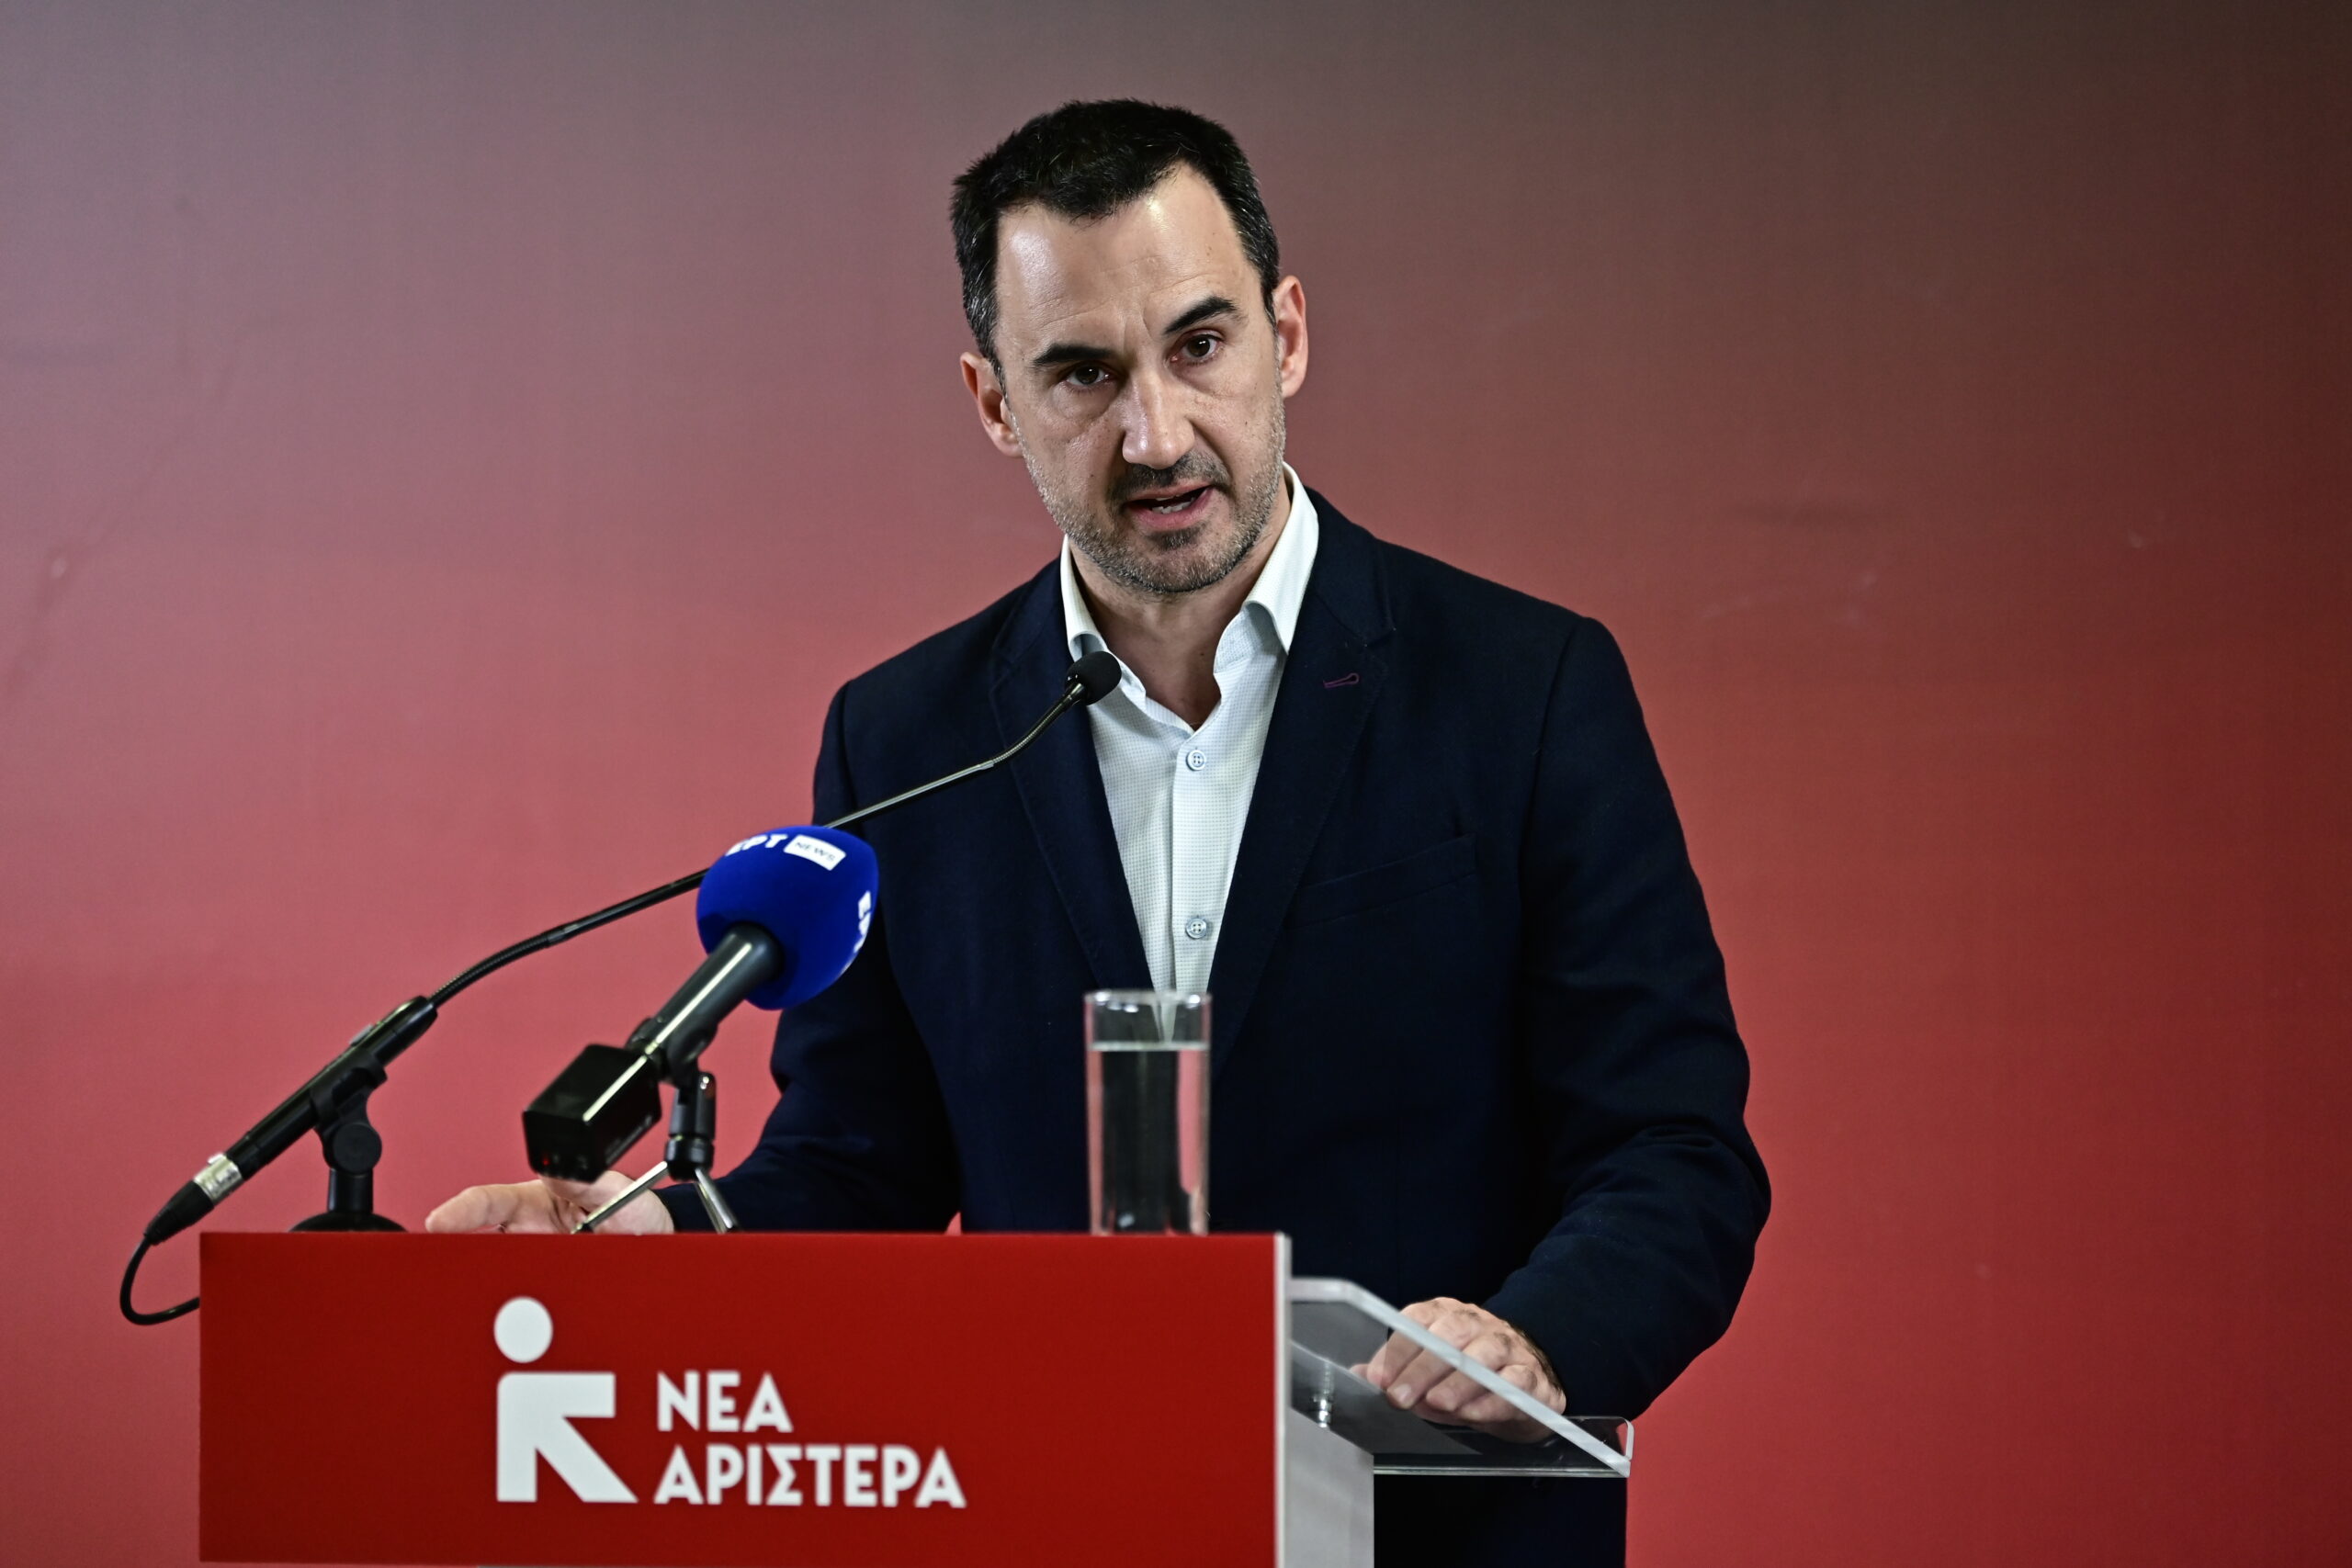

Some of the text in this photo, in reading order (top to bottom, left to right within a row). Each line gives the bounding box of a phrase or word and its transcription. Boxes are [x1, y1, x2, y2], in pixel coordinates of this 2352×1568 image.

[795, 840, 837, 863] NEWS
[657, 1371, 794, 1433] ΝΕΑ
[653, 1443, 967, 1508] ΑΡΙΣΤΕΡΑ
